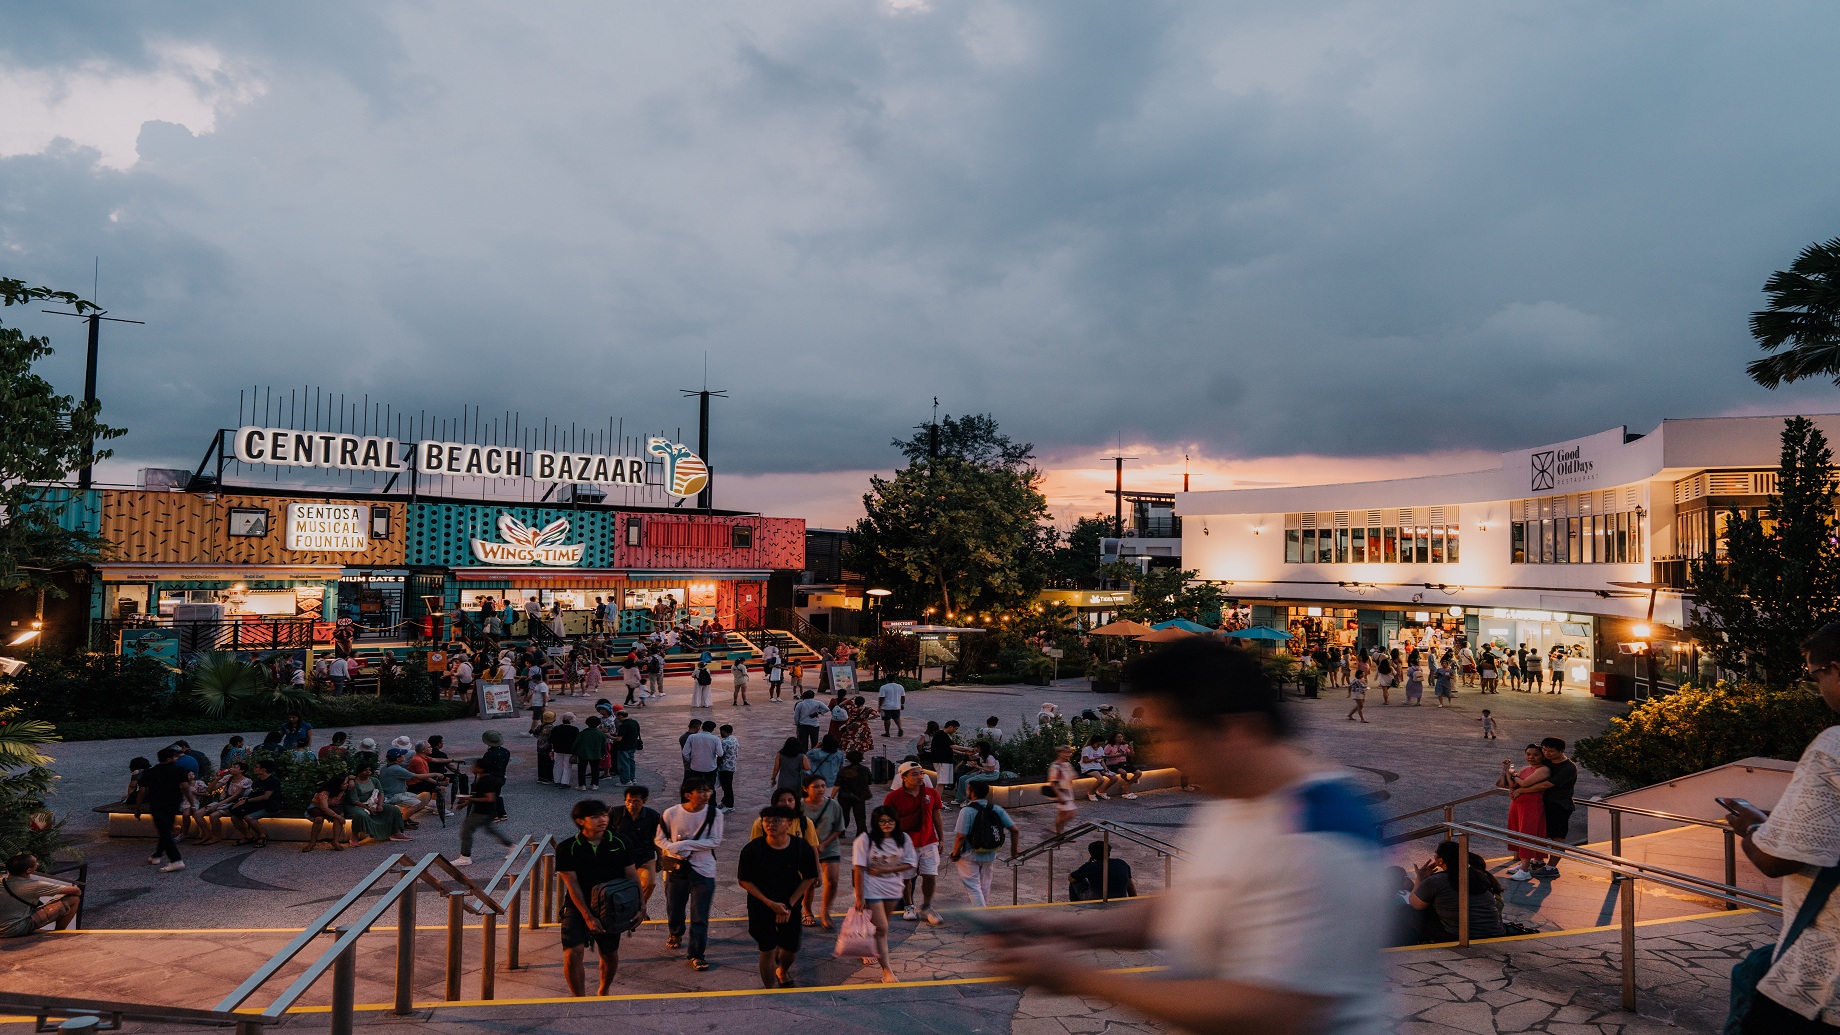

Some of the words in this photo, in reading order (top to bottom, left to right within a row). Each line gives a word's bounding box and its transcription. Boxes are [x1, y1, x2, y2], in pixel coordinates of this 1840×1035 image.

[245, 430, 400, 468] CENTRAL
[426, 443, 522, 476] BEACH
[540, 453, 643, 484] BAZAAR
[1557, 446, 1580, 462] Good
[1557, 461, 1573, 476] Old
[1574, 460, 1593, 474] Days
[1557, 474, 1599, 485] RESTAURANT
[297, 507, 360, 520] SENTOSA
[296, 521, 359, 534] MUSICAL
[295, 535, 365, 548] FOUNTAIN
[479, 542, 535, 561] WINGS
[542, 549, 579, 561] TIME
